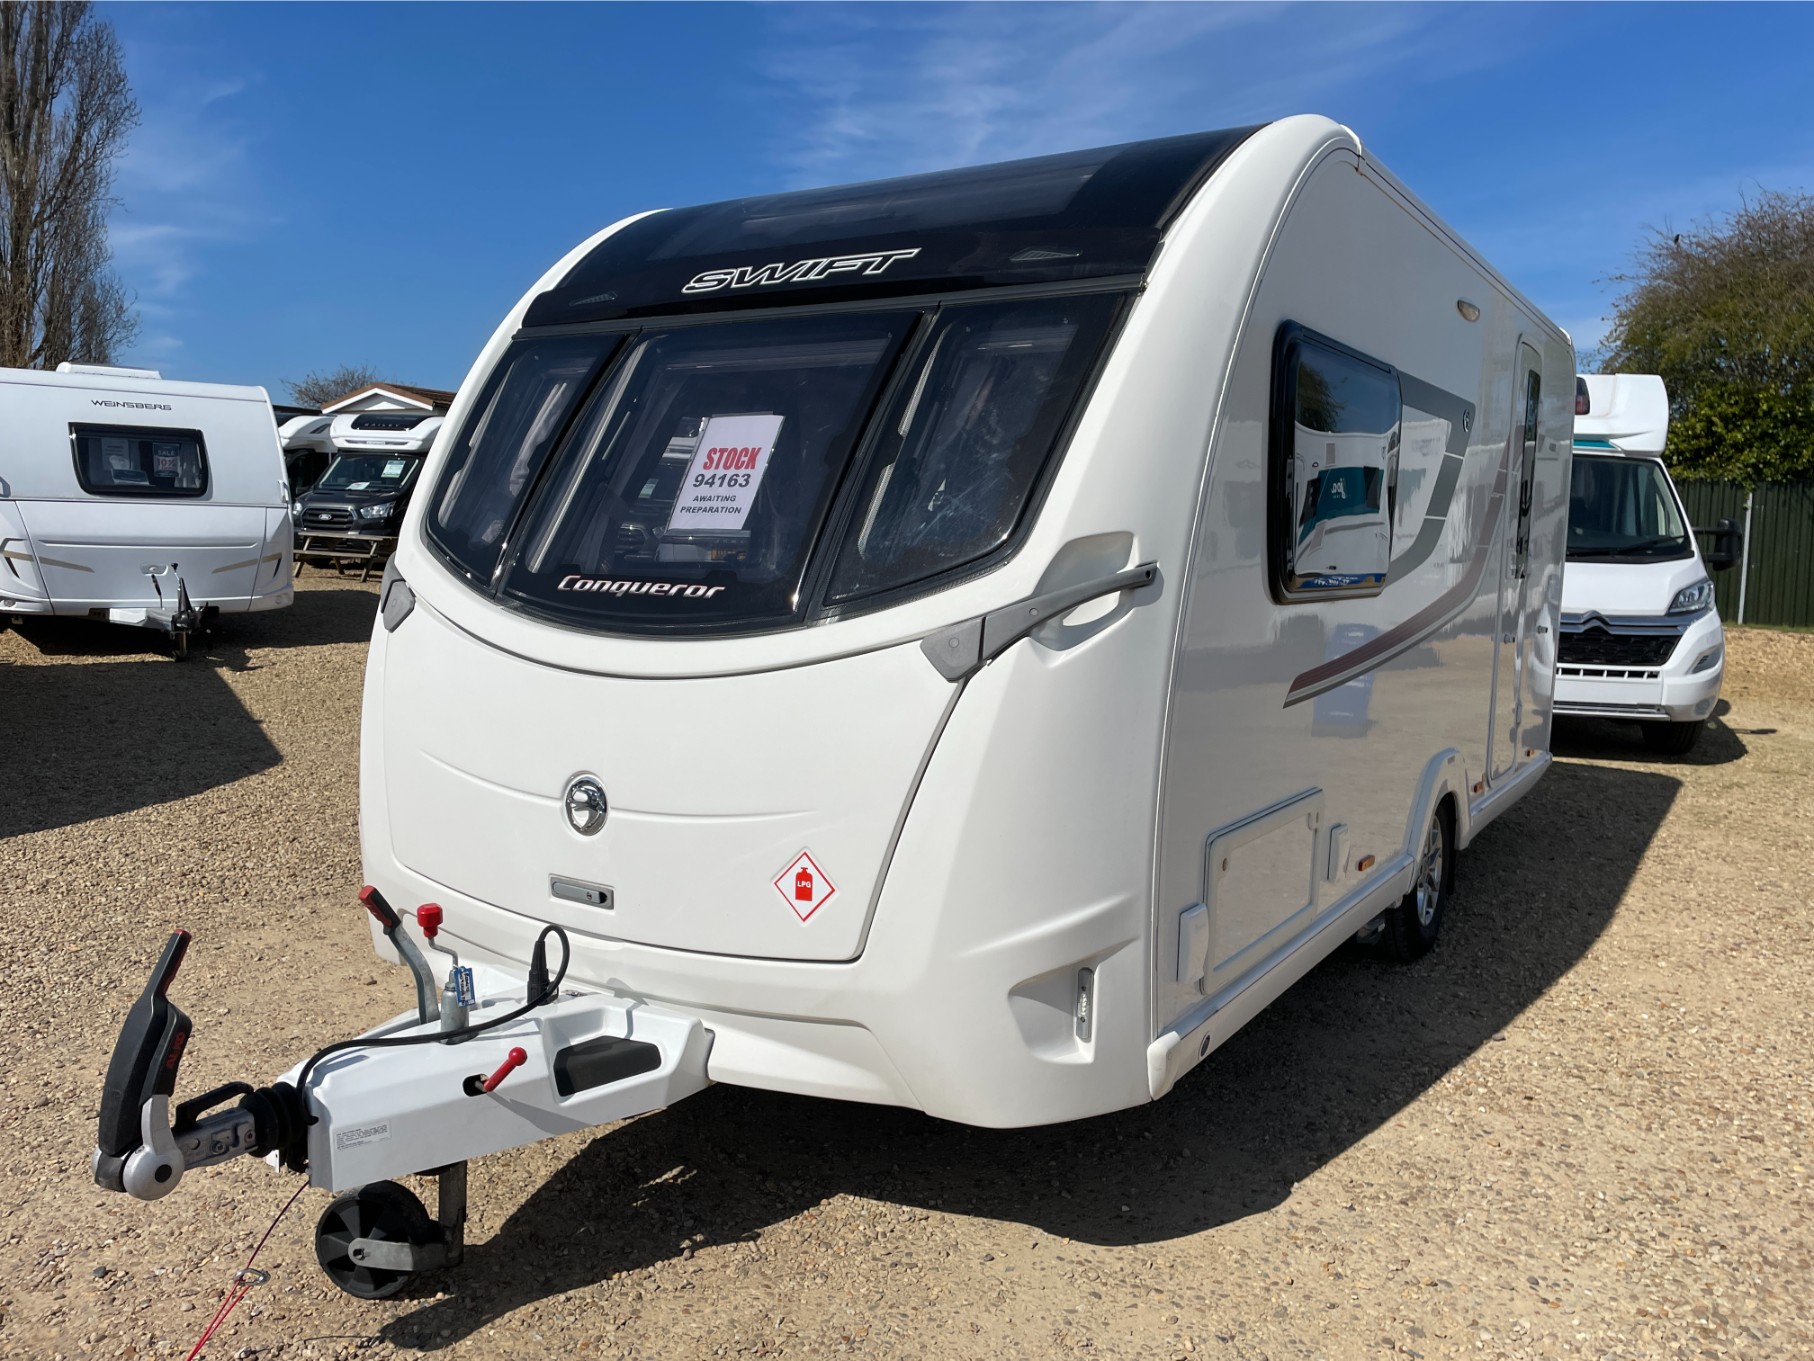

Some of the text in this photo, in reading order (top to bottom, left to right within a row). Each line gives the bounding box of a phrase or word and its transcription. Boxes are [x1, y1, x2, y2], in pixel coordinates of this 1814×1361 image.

[681, 247, 922, 294] SWIFT
[91, 399, 172, 410] WEINSBERG
[703, 447, 762, 470] STOCK
[693, 473, 751, 488] 94163
[680, 506, 742, 514] PREPARATION
[557, 574, 726, 599] Conqueror
[797, 880, 812, 889] LPG
